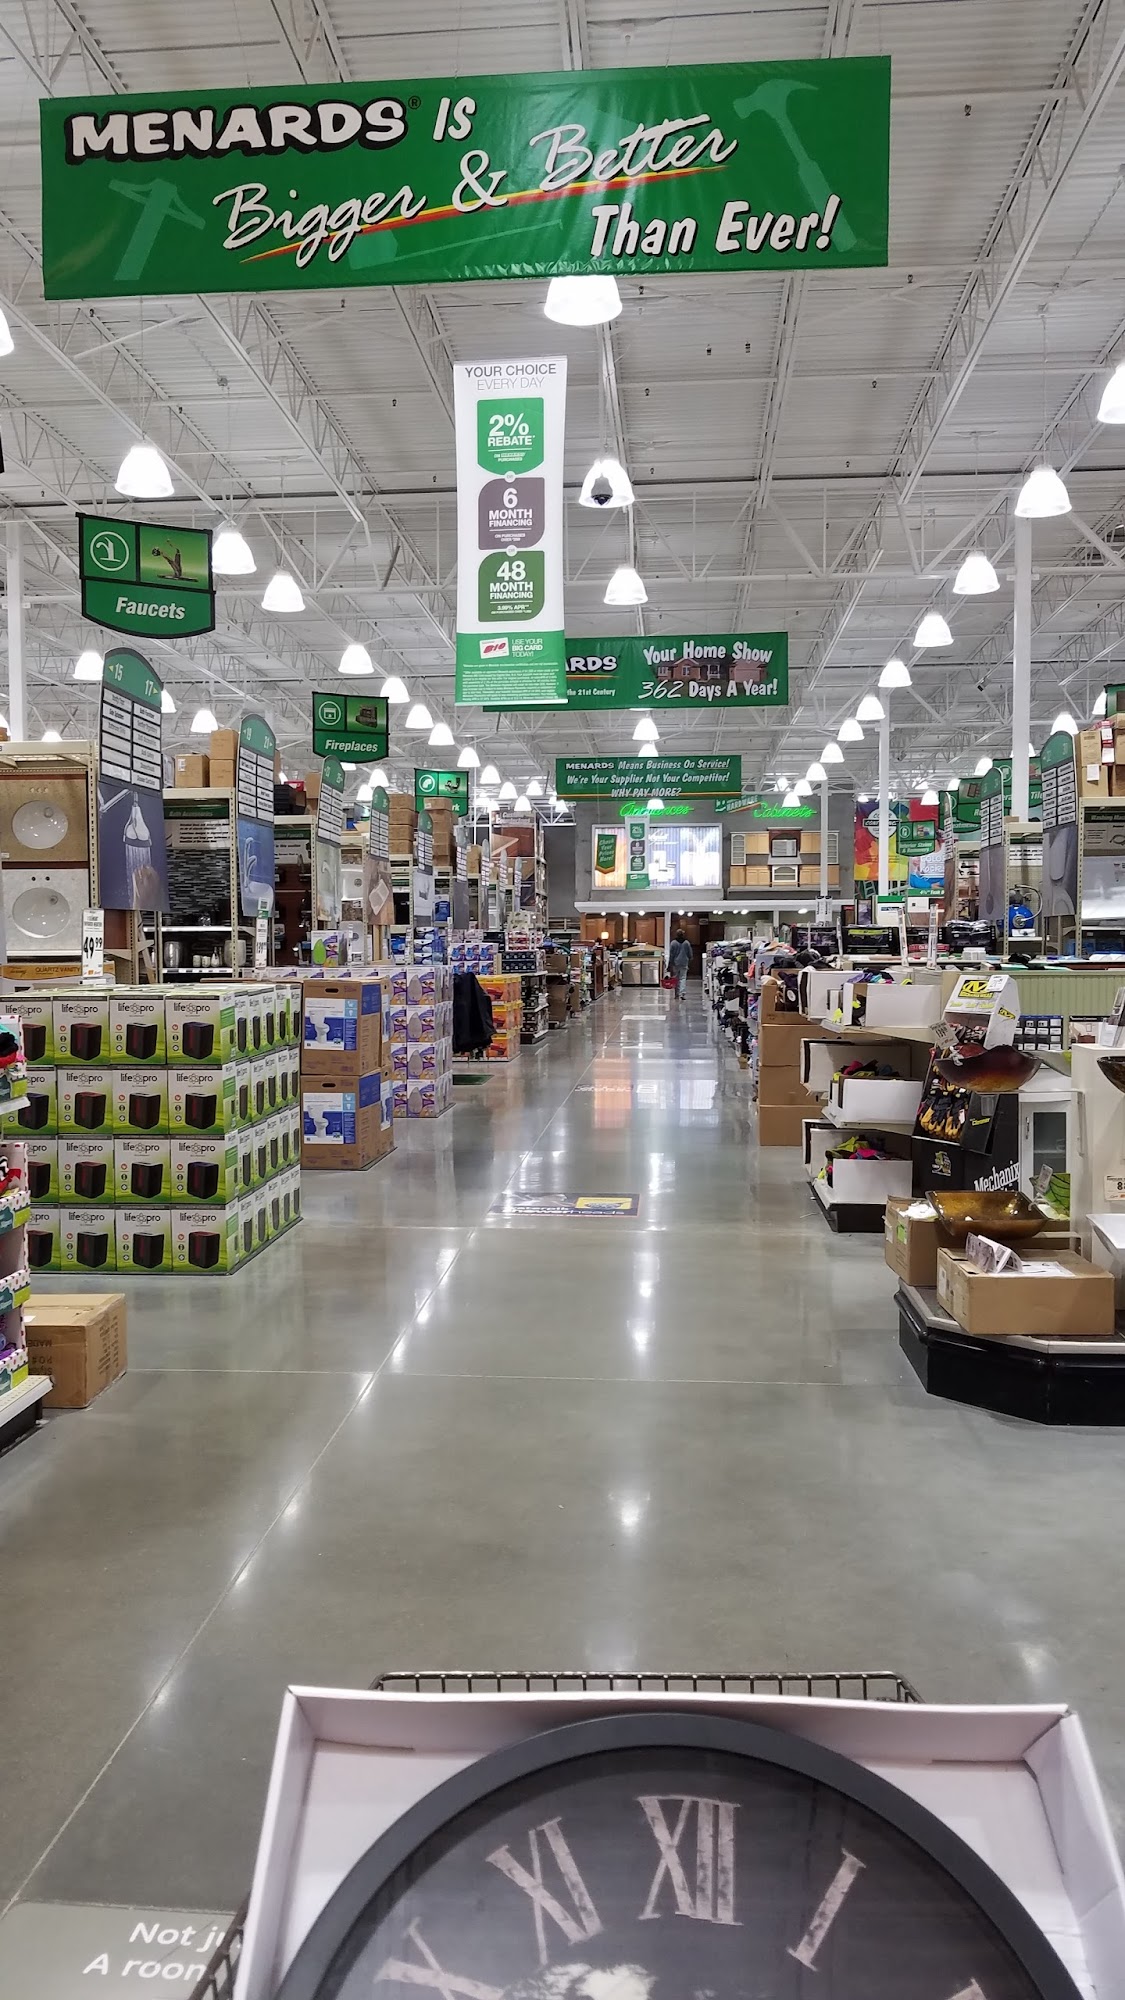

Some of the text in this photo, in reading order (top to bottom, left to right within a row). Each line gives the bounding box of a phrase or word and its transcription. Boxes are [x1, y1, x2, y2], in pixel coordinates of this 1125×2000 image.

[433, 96, 476, 141] IS
[212, 113, 738, 268] Bigger & Better
[590, 194, 842, 257] Than Ever!
[464, 363, 557, 378] YOUR CHOICE
[477, 377, 544, 391] EVERY DAY
[489, 413, 530, 437] 2%
[503, 487, 518, 508] 6
[489, 509, 533, 520] MONTH
[489, 518, 533, 528] FINANCING
[496, 560, 526, 581] 48
[489, 581, 533, 592] MONTH
[489, 591, 533, 600] FINANCING
[115, 596, 186, 620] Faucets
[643, 640, 773, 665] Your Home Show
[114, 662, 124, 681] 15
[145, 679, 154, 697] 17
[592, 687, 616, 697] Century
[638, 678, 778, 701] 362 Days A Year!
[324, 739, 379, 753] Fireplaces
[565, 758, 730, 770] MENARDS Means Business On Service!
[566, 772, 730, 786] We're Your Supplier Not Your Competitor!
[611, 787, 682, 798] WHY PAY MORE?
[5, 1004, 42, 1016] life pro
[61, 1003, 99, 1015] life pro
[117, 1002, 155, 1014] life pro
[173, 1002, 211, 1014] life pro
[30, 1075, 46, 1085] pro
[66, 1072, 103, 1084] life pro
[120, 1072, 158, 1084] life pro
[176, 1072, 214, 1084] life pro
[32, 1144, 47, 1154] pro
[66, 1142, 103, 1154] life pro
[123, 1142, 160, 1154] life pro
[178, 1142, 216, 1154] life pro
[35, 1213, 50, 1222] pro
[68, 1211, 105, 1223] life pro
[124, 1212, 161, 1224] life pro
[179, 1212, 217, 1224] life pro
[636, 1794, 744, 1926] XII
[129, 1922, 197, 1947] Not
[82, 1953, 109, 1976] A
